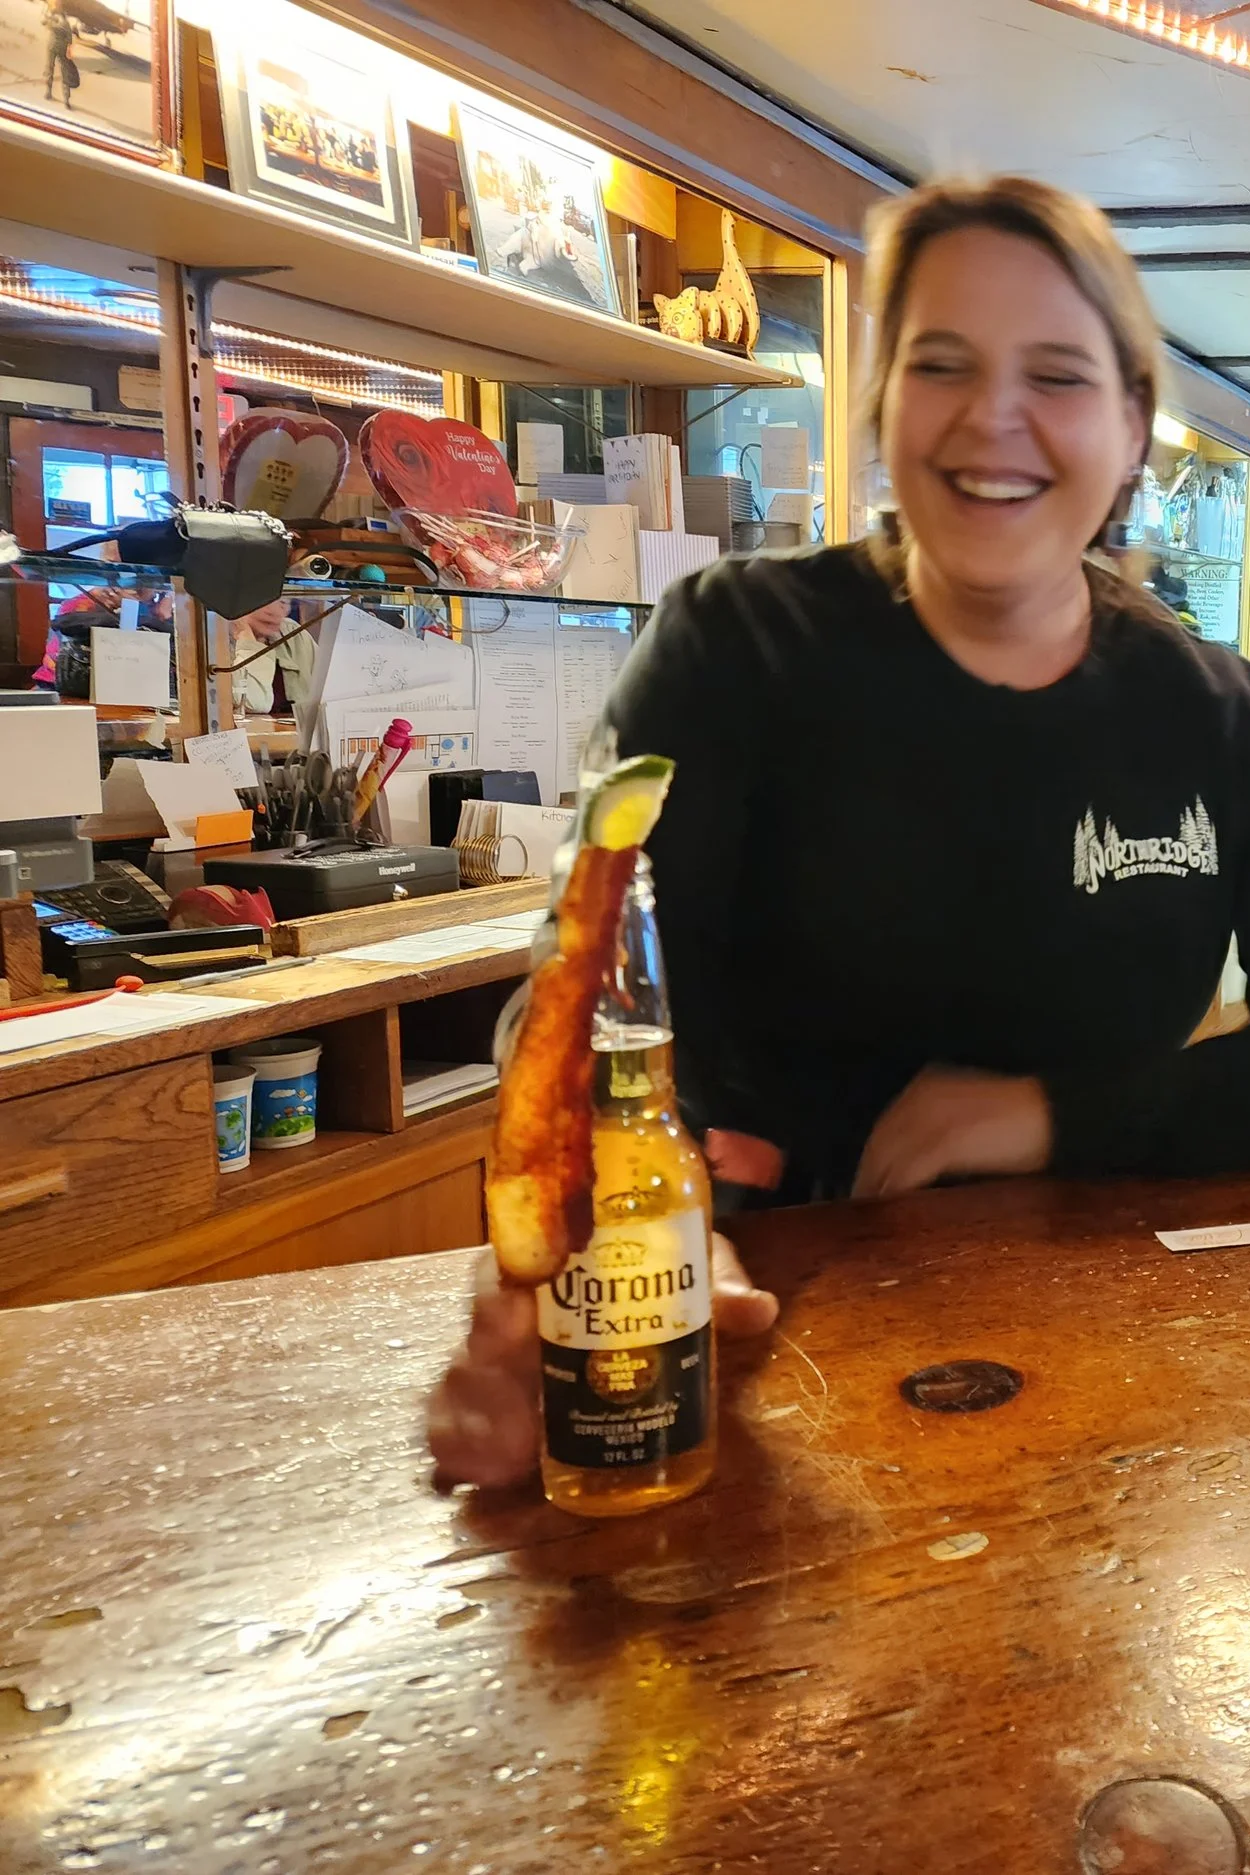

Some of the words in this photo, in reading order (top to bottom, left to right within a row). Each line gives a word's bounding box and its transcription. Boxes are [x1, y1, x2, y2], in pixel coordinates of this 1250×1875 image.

[445, 431, 476, 446] Happy
[478, 462, 497, 476] Day
[1181, 568, 1228, 579] WARNING:
[378, 862, 416, 876] Honeywell
[1085, 837, 1211, 894] NORTHRIDGE
[1113, 862, 1190, 881] RESTAURANT
[552, 1262, 696, 1316] Corona
[586, 1309, 664, 1335] Extra
